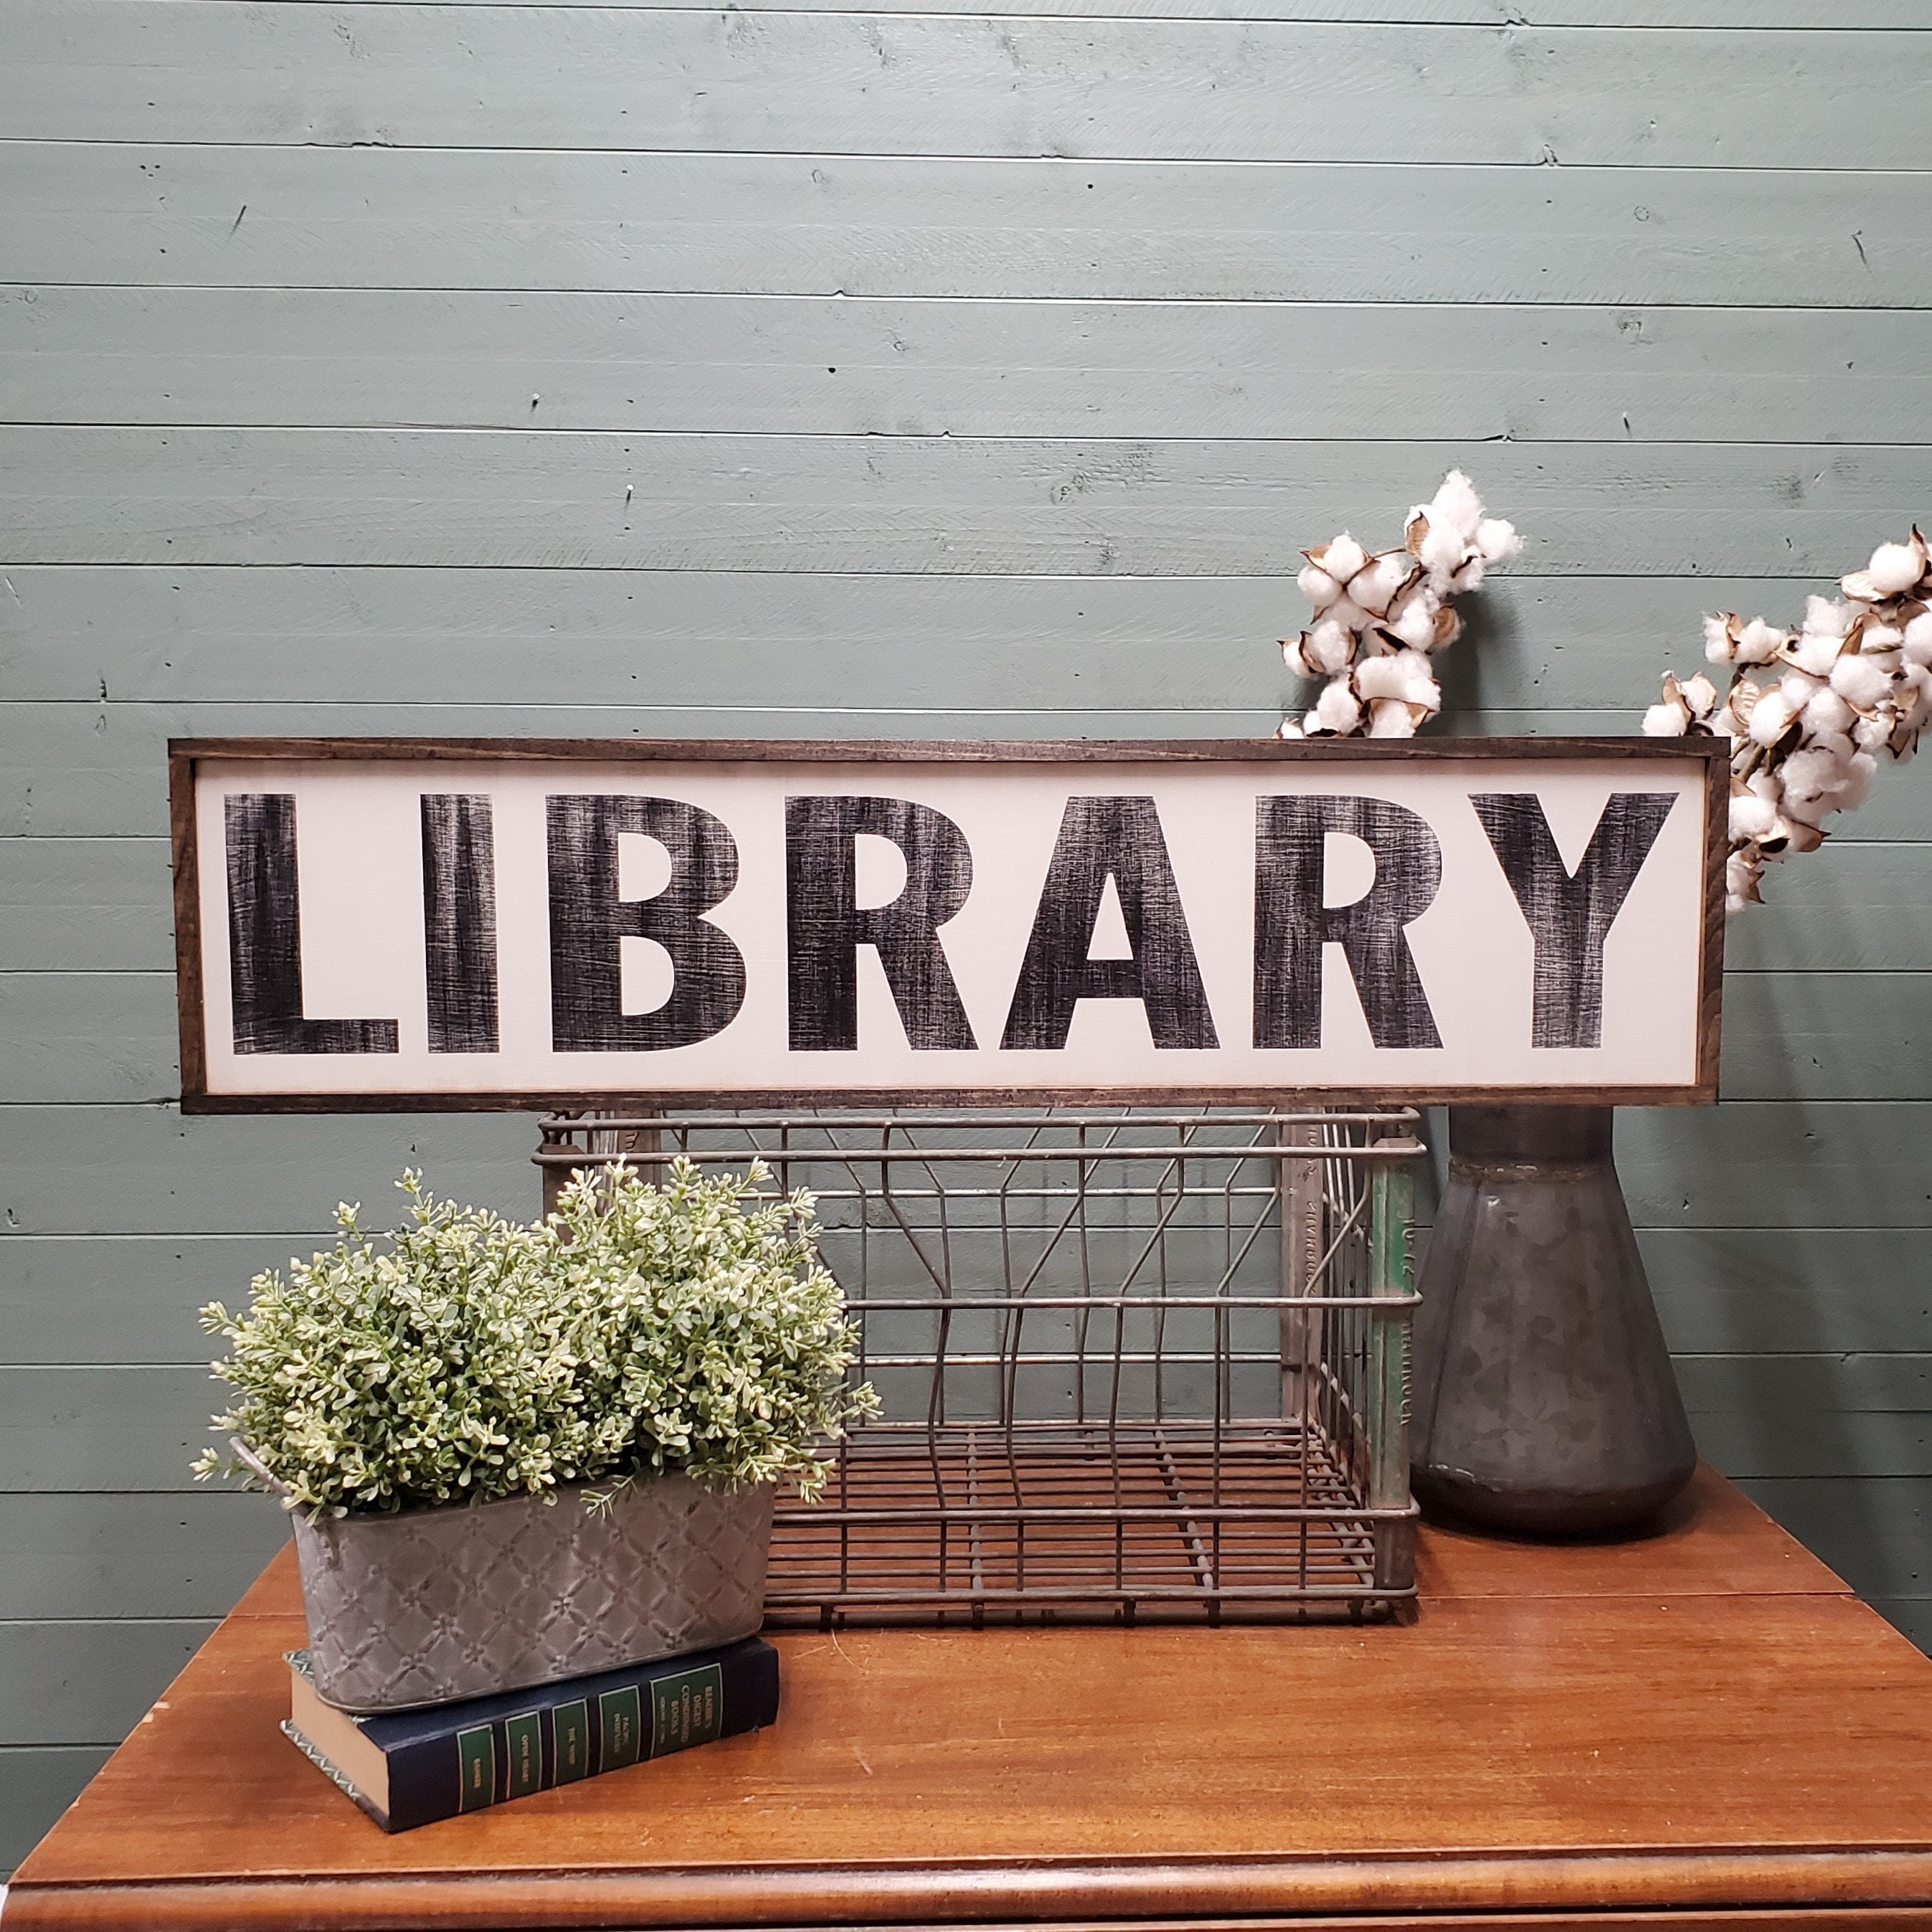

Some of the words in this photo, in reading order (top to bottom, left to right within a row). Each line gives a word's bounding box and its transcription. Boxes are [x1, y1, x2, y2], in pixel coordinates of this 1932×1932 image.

[224, 792, 1679, 1054] LIBRARY
[671, 1700, 680, 1736] BOOKS
[693, 1694, 702, 1727] DIGEST
[521, 1734, 529, 1756] OPEN
